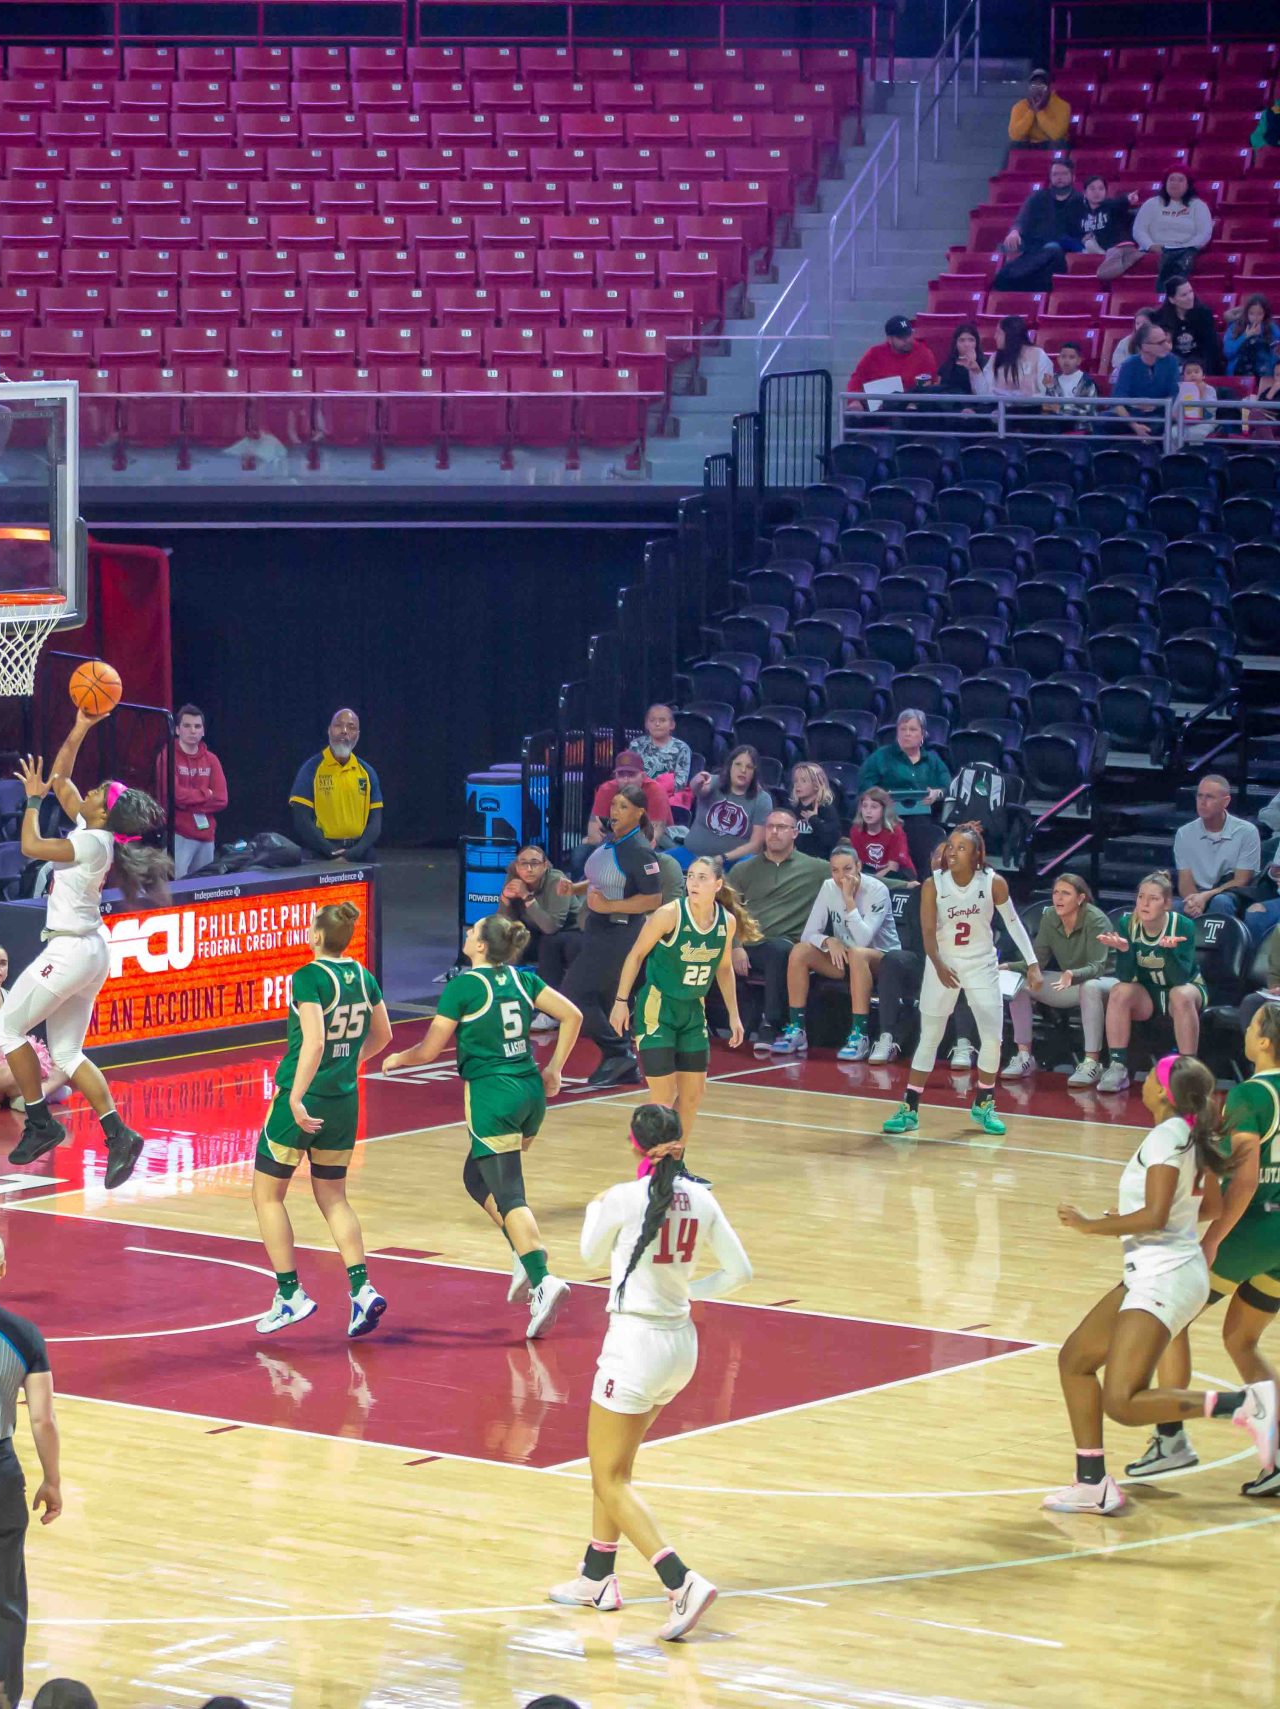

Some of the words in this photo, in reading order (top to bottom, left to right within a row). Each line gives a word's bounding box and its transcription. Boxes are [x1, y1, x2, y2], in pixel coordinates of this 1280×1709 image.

[320, 872, 357, 884] Independence
[194, 889, 233, 900] Independence
[468, 893, 499, 903] POWERA
[198, 902, 317, 940] PHILADELPHIA
[947, 904, 980, 919] Temple
[98, 911, 195, 978] FCU
[198, 938, 242, 958] FEDERAL
[246, 932, 282, 951] CREDIT
[286, 928, 310, 946] UNIO
[954, 922, 971, 946] 2
[683, 965, 711, 986] 22
[110, 998, 133, 1033] AN
[142, 985, 226, 1028] ACCOUNT
[234, 980, 255, 1015] AT
[263, 975, 293, 1011] PFC
[327, 1001, 368, 1041] 55
[500, 1001, 523, 1039] 5
[652, 1218, 699, 1264] 14
